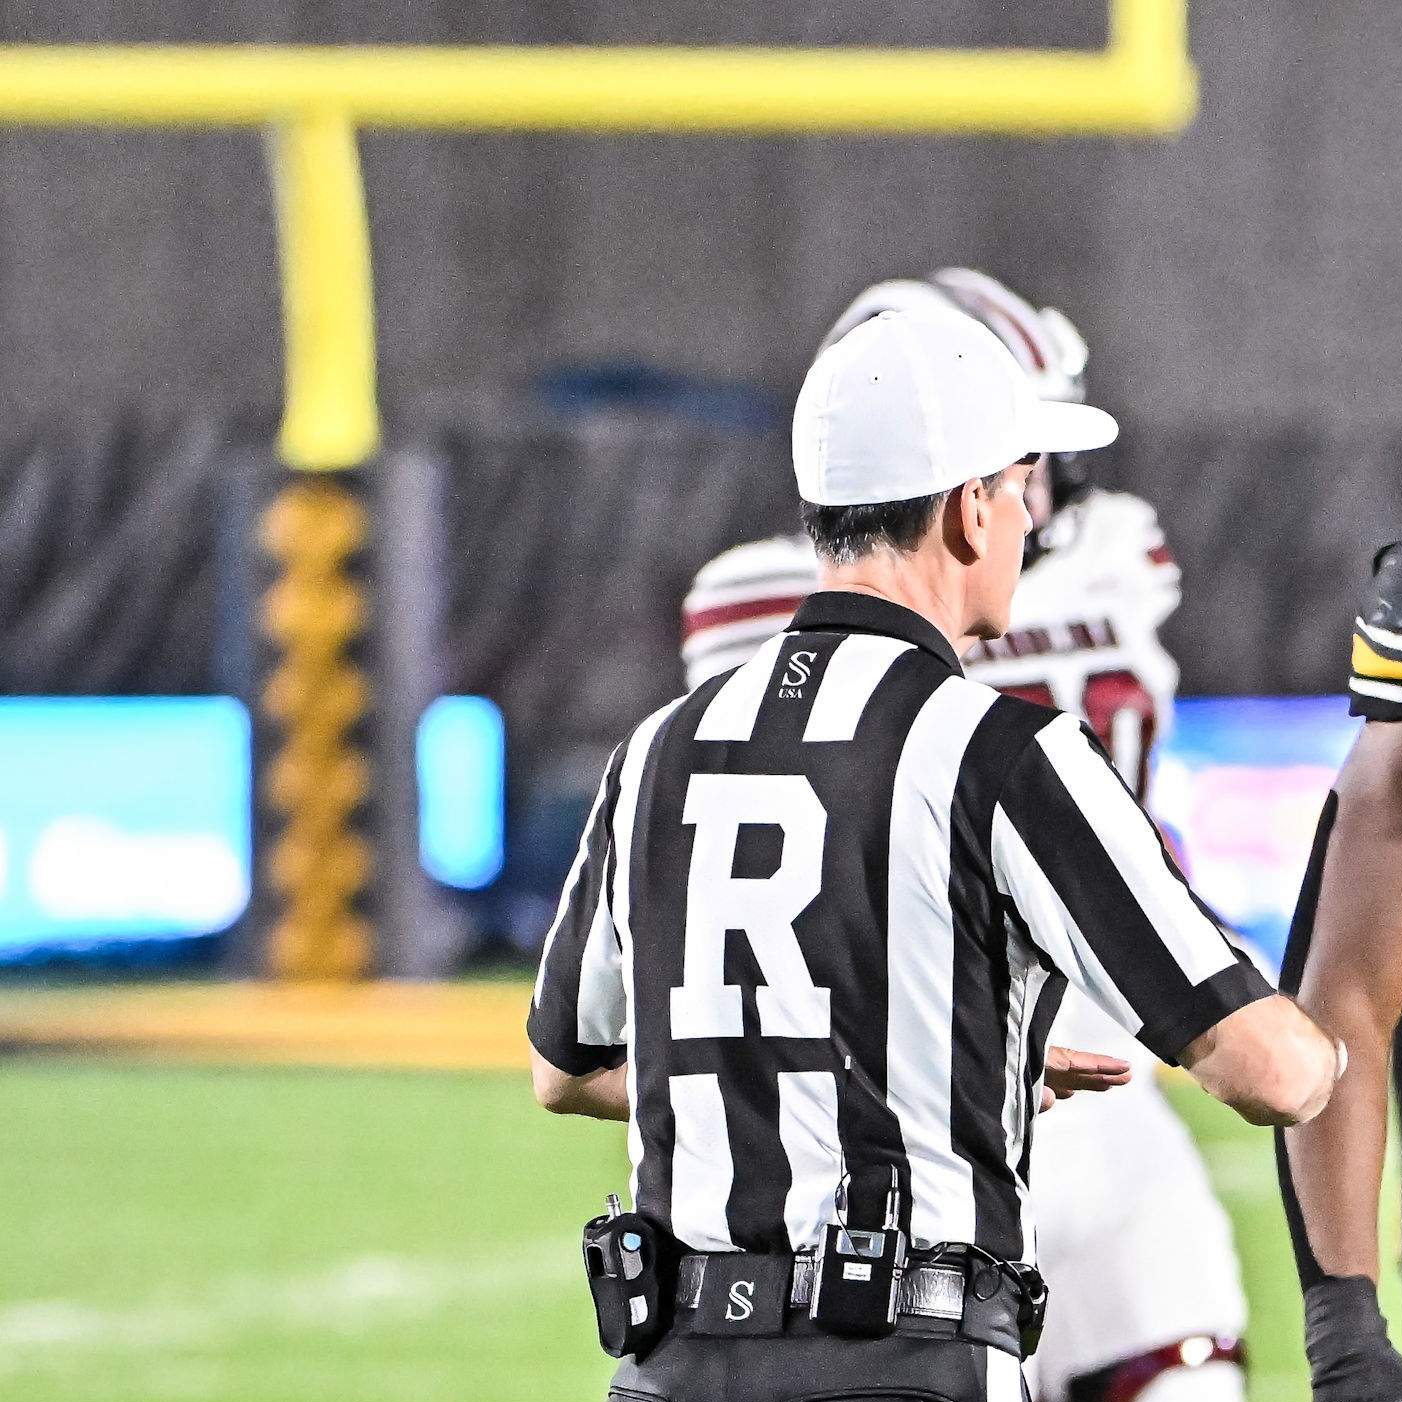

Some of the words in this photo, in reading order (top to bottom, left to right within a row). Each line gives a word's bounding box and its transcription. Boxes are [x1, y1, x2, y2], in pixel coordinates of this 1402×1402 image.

[778, 688, 803, 699] USA
[670, 773, 831, 1040] R
[724, 1280, 756, 1321] S
